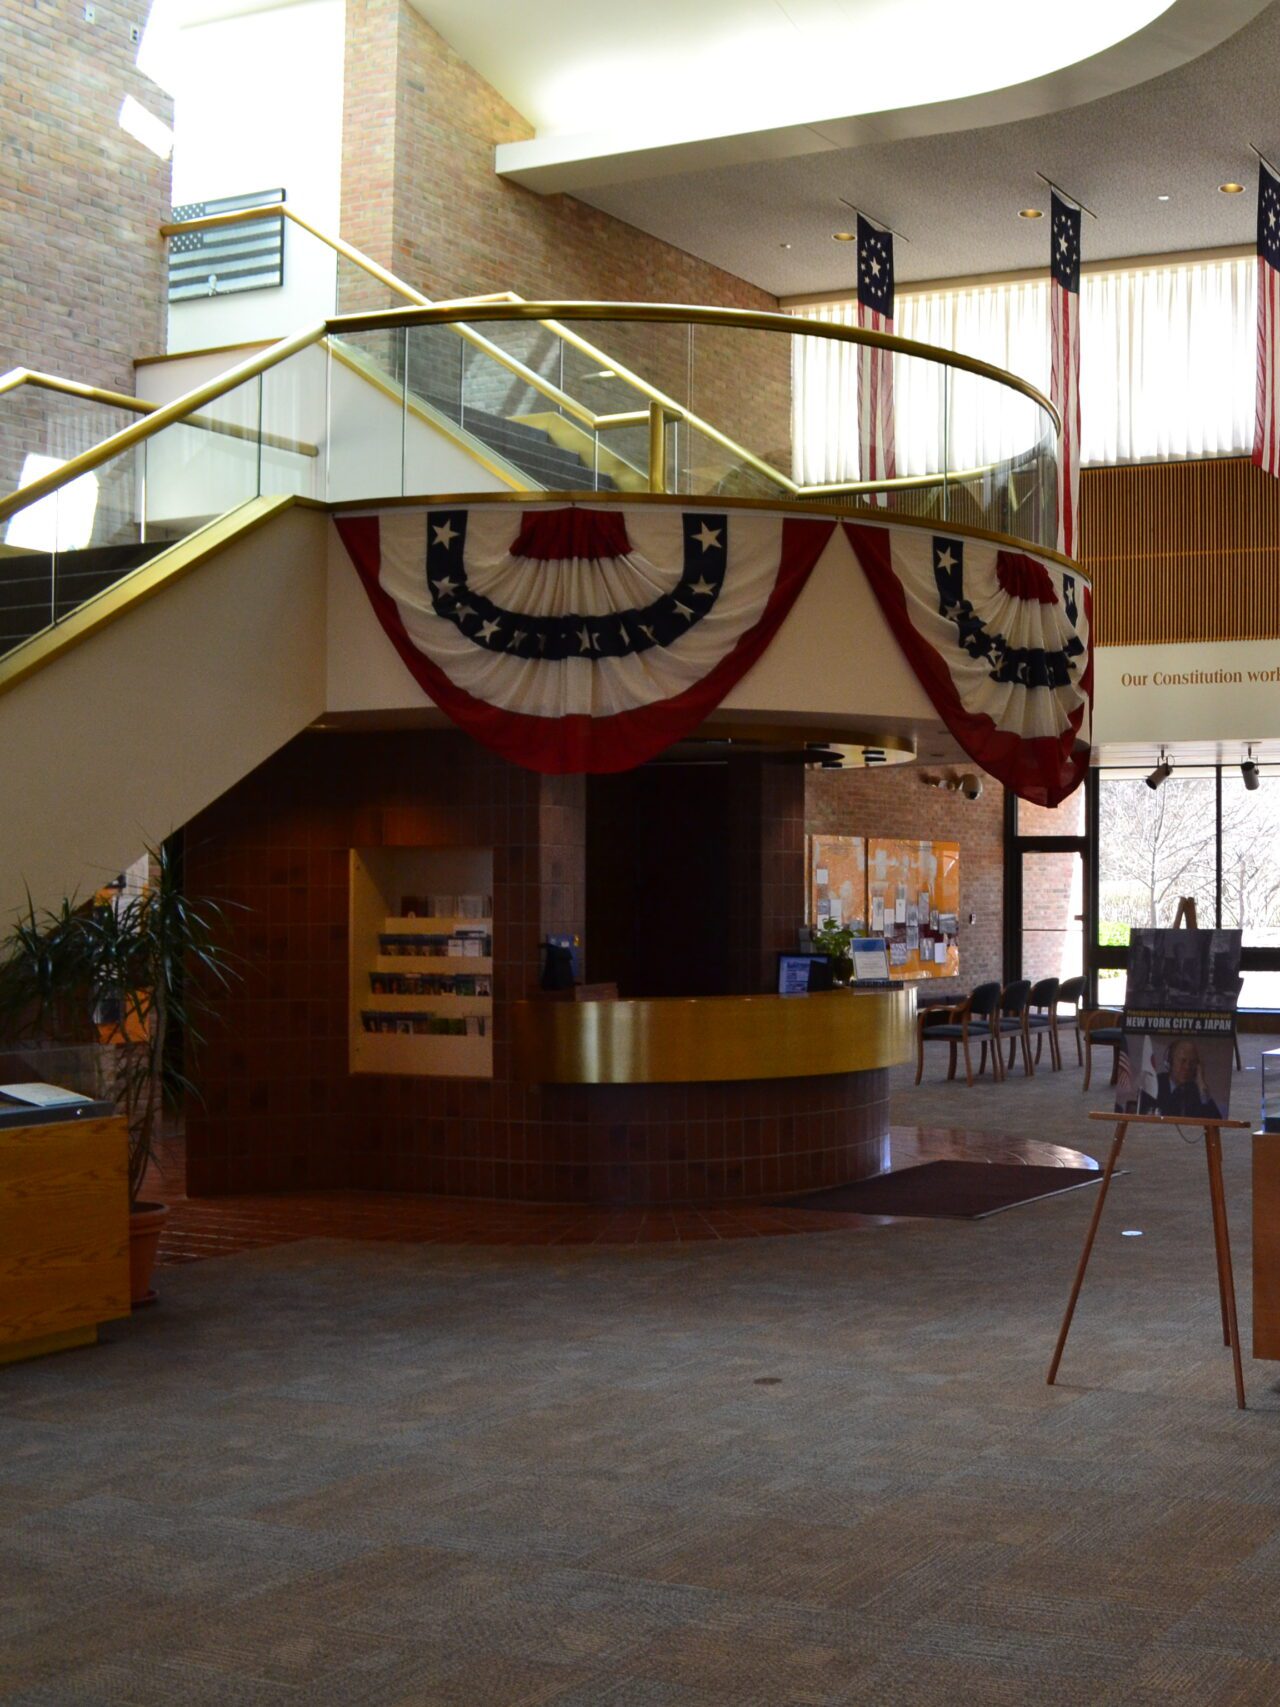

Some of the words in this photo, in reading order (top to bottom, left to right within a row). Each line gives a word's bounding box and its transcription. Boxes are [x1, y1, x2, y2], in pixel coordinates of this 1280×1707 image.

[1120, 672, 1149, 688] Our
[1152, 668, 1243, 687] Constitution
[1126, 1017, 1145, 1027] NEW
[1147, 1017, 1171, 1028] YORK
[1172, 1018, 1194, 1029] CITY
[1195, 1020, 1202, 1029] &
[1203, 1019, 1232, 1030] JAPAN
